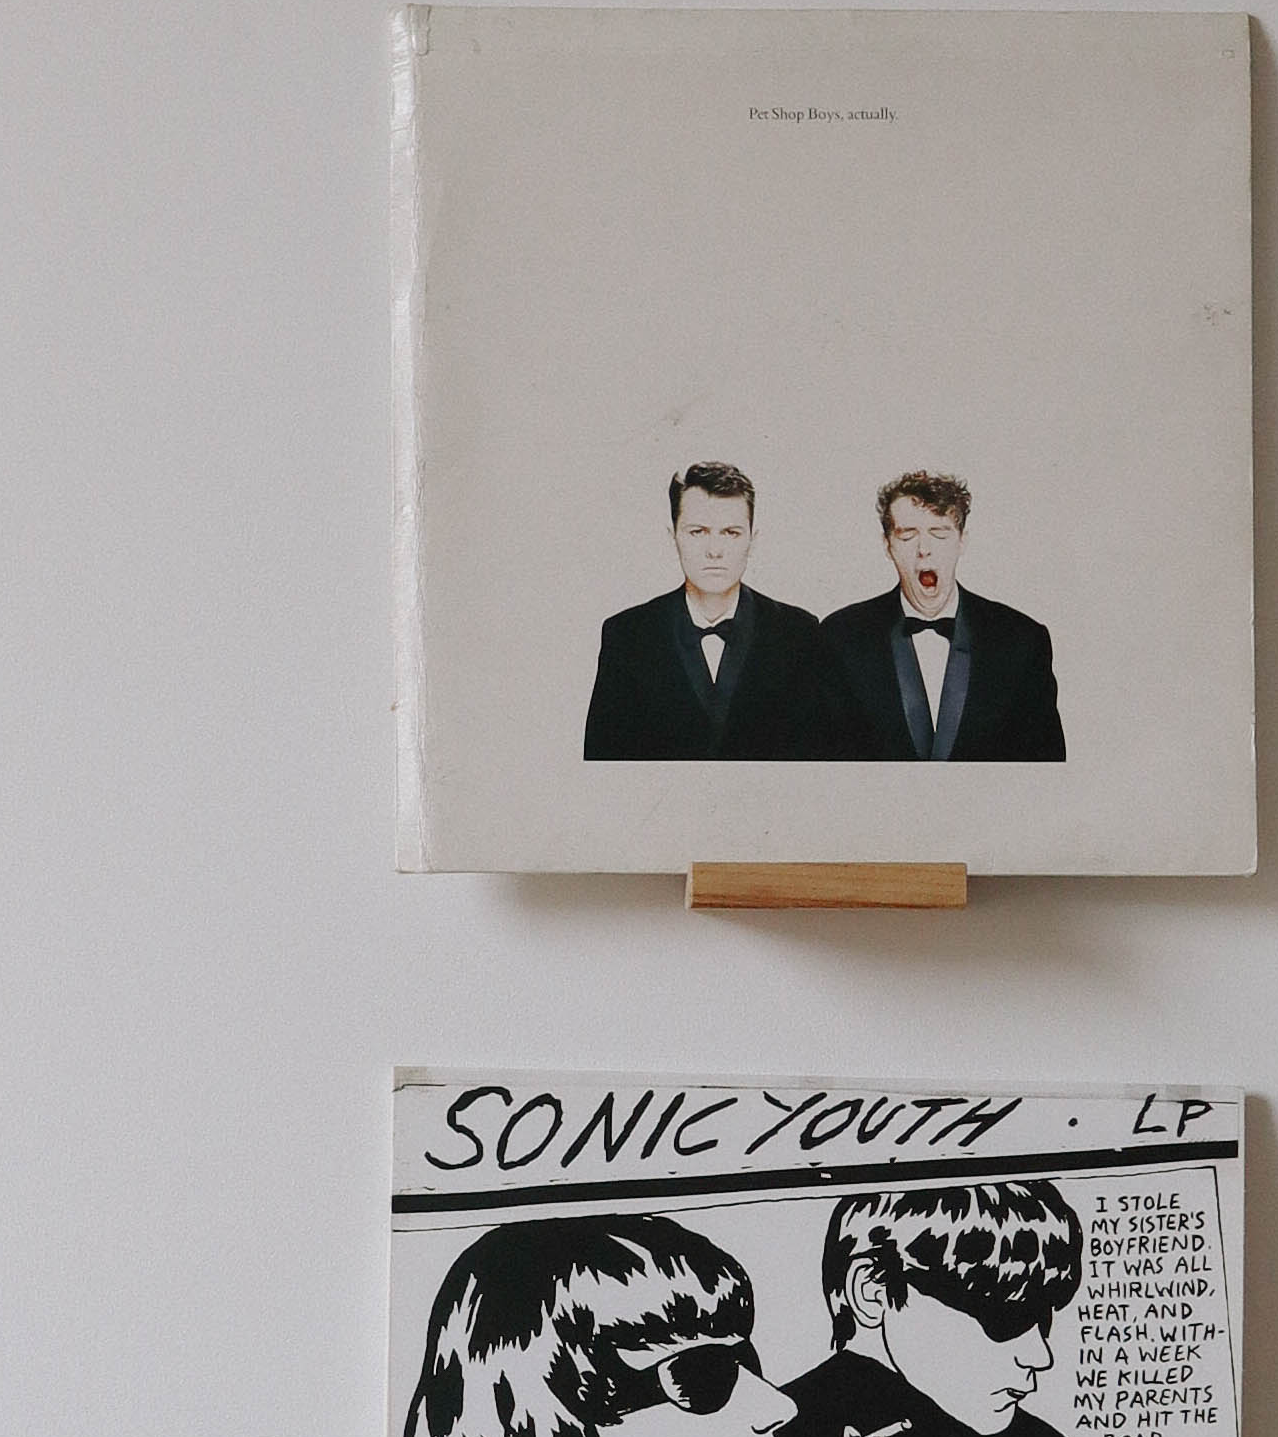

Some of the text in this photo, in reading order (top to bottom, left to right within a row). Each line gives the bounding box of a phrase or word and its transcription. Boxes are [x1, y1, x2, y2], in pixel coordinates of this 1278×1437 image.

[749, 107, 899, 124] Pet Shop Boys, actually.
[425, 1086, 1023, 1170] SONIC YOUTH
[1132, 1097, 1214, 1140] LP
[1096, 1192, 1181, 1213] I STOLE
[1091, 1211, 1205, 1235] MY SISTER'S
[1090, 1234, 1212, 1257] BOYFRIEND.
[1089, 1255, 1212, 1278] IT WAS ALL
[1087, 1278, 1215, 1300] WHIRLWIND,
[1078, 1302, 1193, 1324] HEAT, AND
[1081, 1323, 1225, 1343] FLASH. WITH-
[1080, 1344, 1202, 1365] IN A WEEK
[1076, 1365, 1194, 1388] WE KILLED
[1074, 1385, 1213, 1411] MY PARENTS
[1075, 1407, 1219, 1430] AND HIT THE
